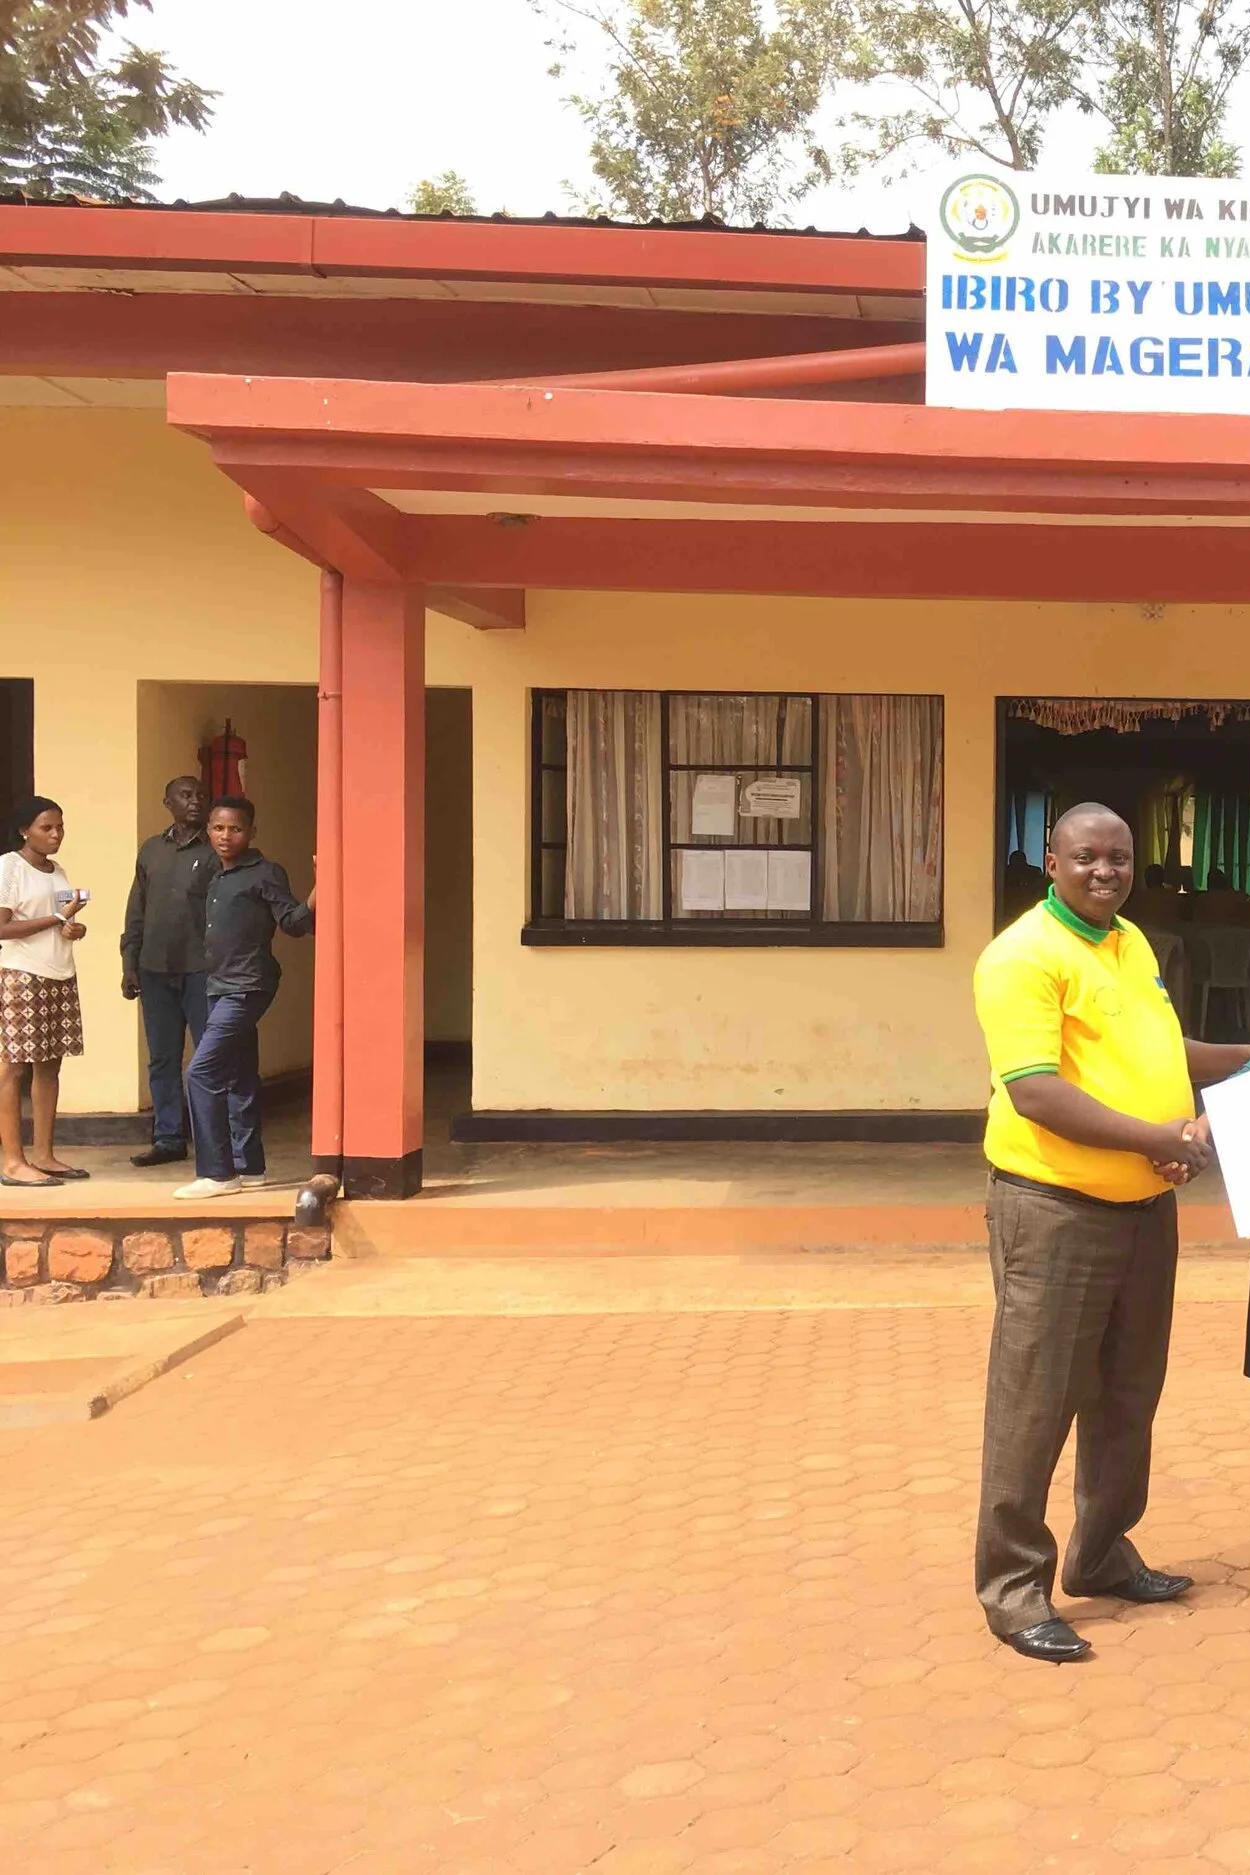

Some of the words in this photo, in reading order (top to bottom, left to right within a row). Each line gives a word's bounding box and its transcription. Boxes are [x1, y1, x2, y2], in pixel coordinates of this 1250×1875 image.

[1031, 193, 1150, 219] UMUJYI
[1164, 198, 1204, 220] WA
[1031, 231, 1147, 258] AKARERE
[1160, 236, 1192, 258] KA
[942, 275, 1069, 313] IBIRO
[944, 331, 1019, 374] WA
